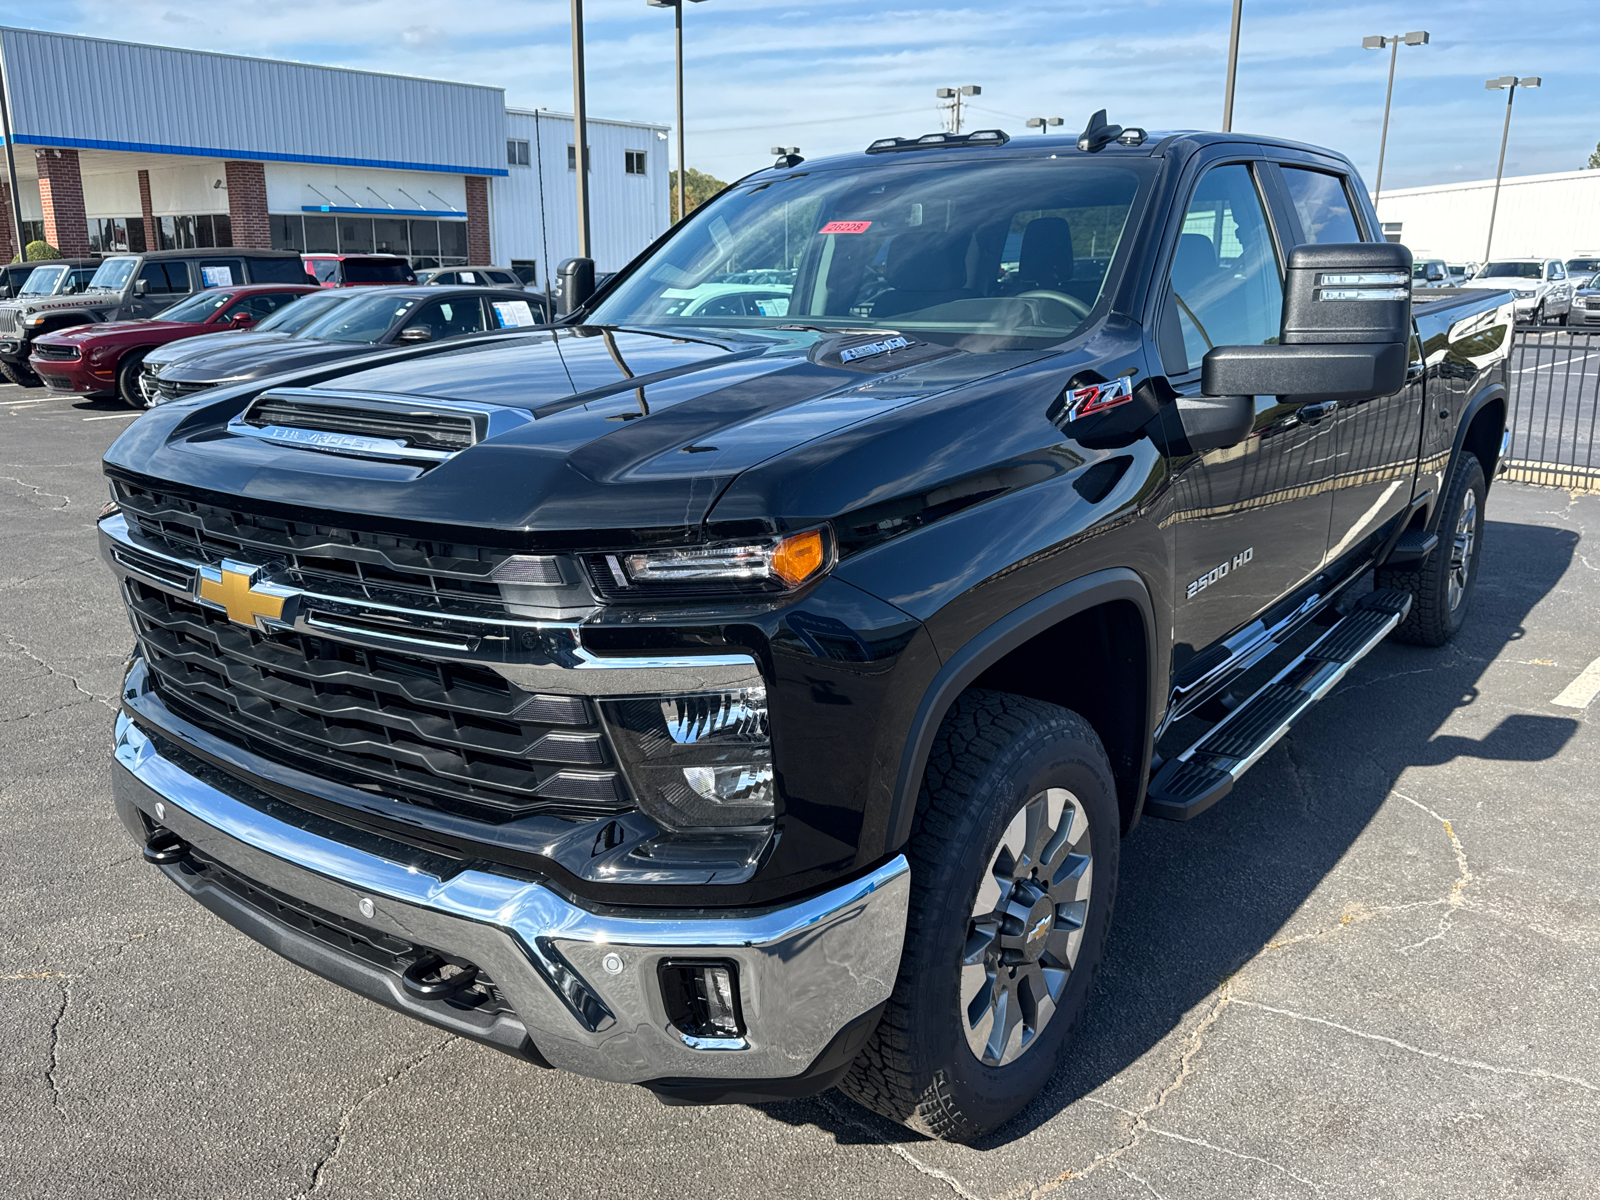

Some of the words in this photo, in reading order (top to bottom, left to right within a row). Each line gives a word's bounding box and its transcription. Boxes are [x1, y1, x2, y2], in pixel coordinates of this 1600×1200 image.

[826, 222, 864, 232] 26228
[41, 300, 103, 309] RUBICON
[1066, 375, 1133, 422] Z71
[272, 428, 379, 450] CHEVROLET
[1185, 561, 1230, 600] 2500
[1230, 546, 1254, 571] HD
